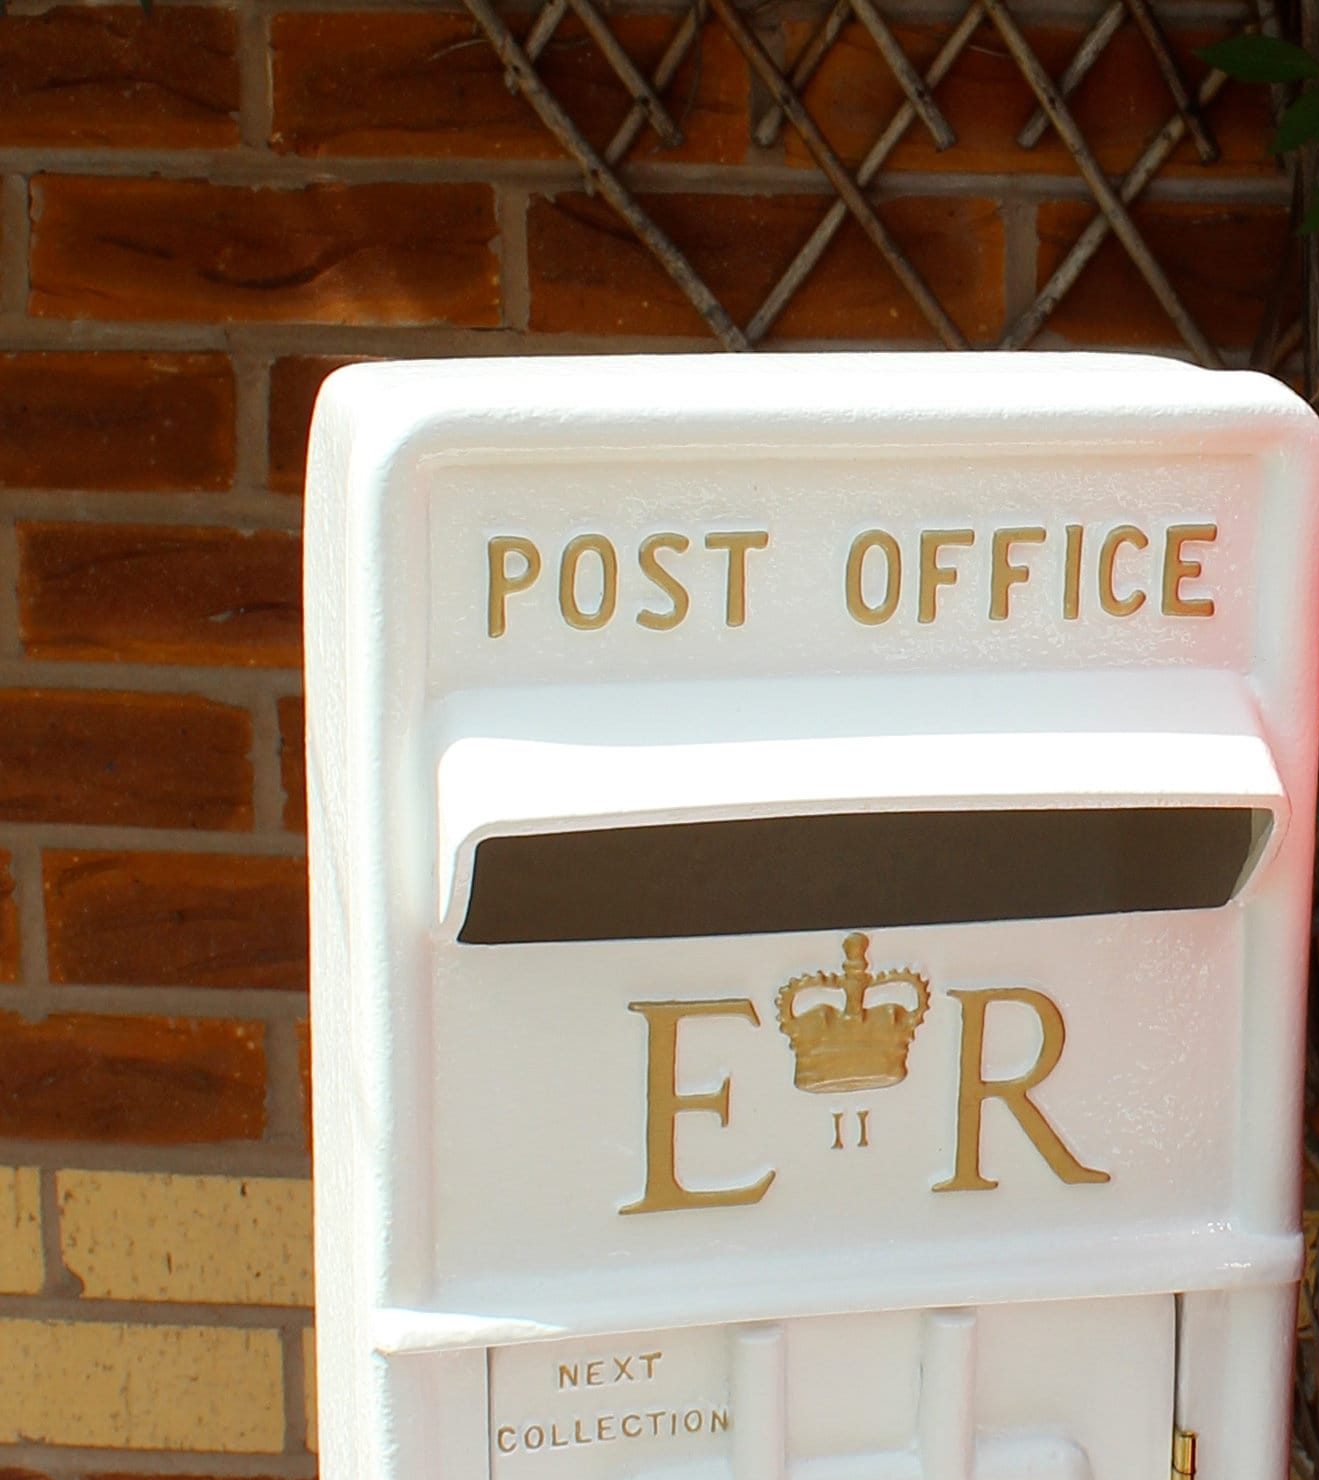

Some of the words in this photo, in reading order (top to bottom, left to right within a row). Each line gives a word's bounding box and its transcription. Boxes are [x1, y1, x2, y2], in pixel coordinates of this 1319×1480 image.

[487, 530, 769, 638] POST
[844, 523, 1218, 625] OFFICE
[617, 997, 777, 1216] E
[930, 986, 1112, 1192] R
[830, 1109, 870, 1150] II
[559, 1352, 662, 1388] NEXT
[498, 1409, 730, 1452] COLLECTION
